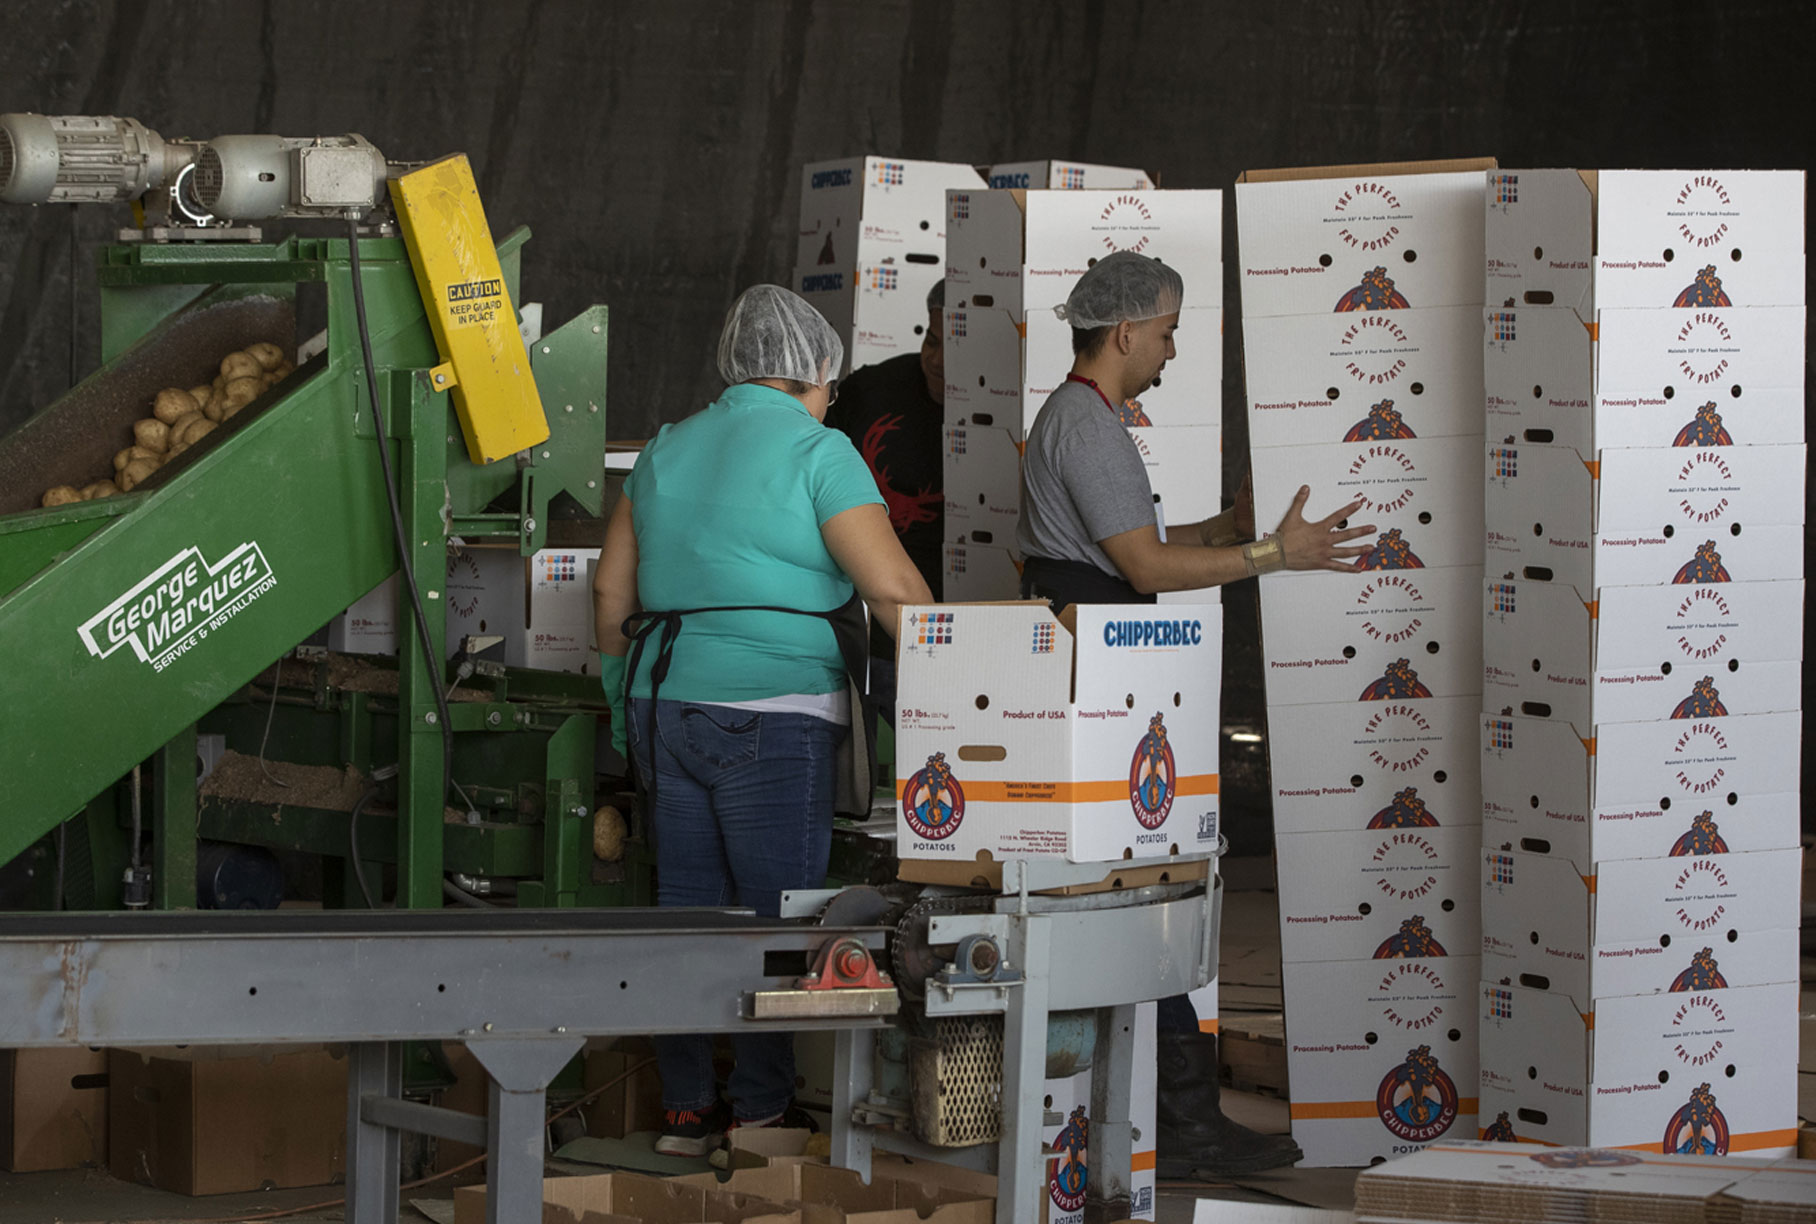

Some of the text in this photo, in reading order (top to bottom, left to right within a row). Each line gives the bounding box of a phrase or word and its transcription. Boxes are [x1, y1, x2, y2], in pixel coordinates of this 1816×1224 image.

[1335, 182, 1400, 211] THE PERFECT
[1677, 176, 1730, 204] THE PERFECT
[1339, 226, 1399, 251] FRY POTATO
[1679, 223, 1728, 248] FRY POTATO
[1247, 264, 1325, 276] Processing Potatoes
[1601, 259, 1666, 271] Processing Potatoes
[449, 281, 500, 300] CAUTION
[450, 300, 502, 316] KEEP GUARD
[459, 311, 495, 324] IN PLACE
[1342, 316, 1407, 345] THE PERFECT
[1678, 312, 1731, 341] THE PERFECT
[1346, 359, 1406, 384] FRY POTATO
[1680, 359, 1728, 384] FRY POTATO
[1255, 399, 1333, 411] Processing Potatoes
[1601, 397, 1666, 408] Processing Potatoes
[1349, 446, 1415, 474] THE PERFECT
[1678, 452, 1732, 480] THE PERFECT
[1377, 488, 1414, 514] POTATO
[1680, 498, 1728, 523] FRY POTATO
[1601, 537, 1666, 547] Processing Potatoes
[1357, 576, 1423, 604] THE PERFECT
[1677, 588, 1730, 618] THE PERFECT
[153, 575, 278, 673] SERVICE & INSTALLATION
[1103, 620, 1202, 648] CHIPPERBEC
[1362, 619, 1422, 643] FRY POTATO
[1678, 634, 1726, 660] FRY POTATO
[1271, 658, 1349, 669] Processing Potatoes
[1600, 674, 1664, 684] Processing Potatoes
[901, 709, 913, 718] 50
[915, 709, 931, 718] lbs.
[1003, 710, 1066, 720] Product of USA
[1078, 709, 1128, 720] Processing Potatoes
[1365, 705, 1430, 733] THE PERFECT
[1674, 723, 1728, 752] THE PERFECT
[1369, 747, 1429, 772] FRY POTATO
[1279, 786, 1356, 797] Processing Potatoes
[1676, 768, 1724, 794] FRY POTATO
[1132, 789, 1173, 830] CHIPPERBEC
[1599, 810, 1663, 821] Processing Potatoes
[907, 809, 962, 837] CHIPPERBEC
[912, 843, 956, 852] POTATOES
[1136, 833, 1168, 845] POTATOES
[1373, 833, 1438, 861] THE PERFECT
[1675, 860, 1728, 890] THE PERFECT
[1377, 876, 1437, 900] FRY POTATO
[1286, 914, 1364, 924] Processing Potatoes
[1676, 905, 1725, 931] FRY POTATO
[1598, 947, 1663, 958] Processing Potatoes
[1379, 963, 1444, 991] THE PERFECT
[1383, 1006, 1443, 1030] FRY POTATO
[1672, 996, 1726, 1026] THE PERFECT
[1293, 1043, 1370, 1054] Processing Potatoes
[1674, 1040, 1723, 1066] FRY POTATO
[1597, 1083, 1661, 1095] Processing Potatoes
[1383, 1107, 1454, 1138] CHIPPERBEC
[1055, 1214, 1083, 1224] POTATO
